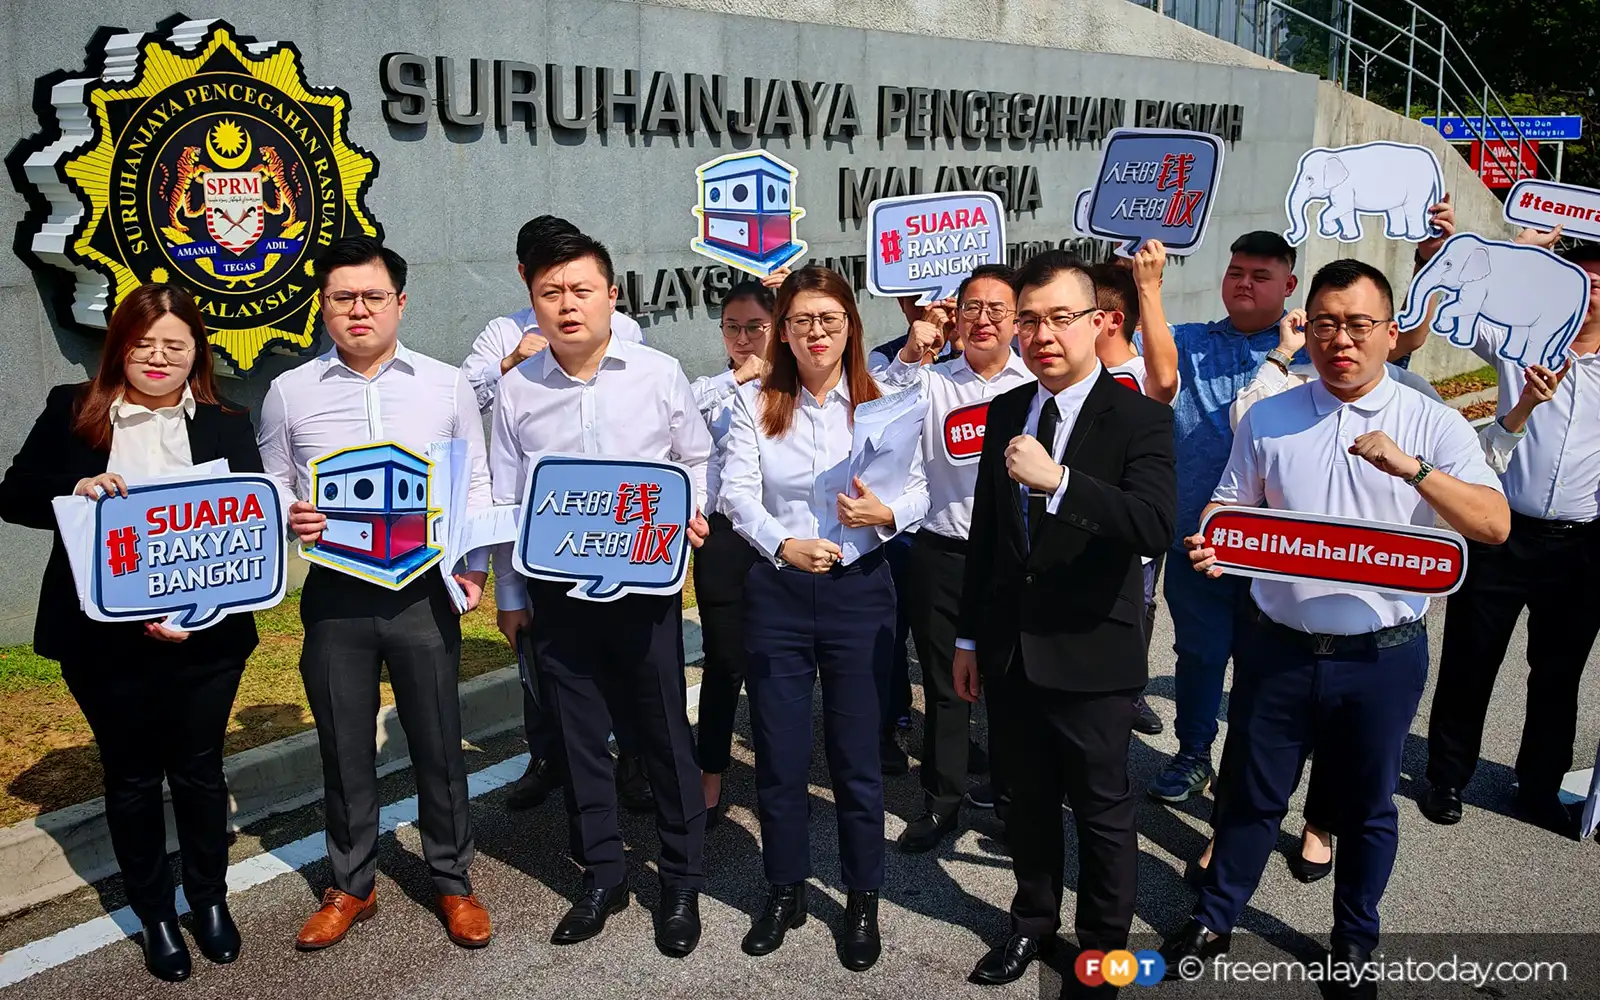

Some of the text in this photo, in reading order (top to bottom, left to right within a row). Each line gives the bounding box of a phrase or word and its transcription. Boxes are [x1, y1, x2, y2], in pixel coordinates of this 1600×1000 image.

[379, 52, 862, 138] SURUHANJAYA
[878, 86, 1125, 141] PENCEGAHAN
[1525, 129, 1565, 137] Malaysia
[120, 83, 336, 255] SURUHANJAYA PENCEGAHAN RASUAH
[206, 177, 260, 195] SPRM
[1104, 152, 1195, 191] 人民的钱
[905, 206, 990, 237] SUARA
[1111, 189, 1204, 227] 人民的权
[177, 245, 217, 257] AMANAH
[265, 241, 289, 250] ADIL
[908, 230, 991, 259] RAKYAT
[223, 262, 256, 272] TEGAS
[908, 253, 990, 281] BANGKIT
[193, 283, 303, 318] ALAYSIA
[145, 492, 267, 538] SUARA
[535, 481, 663, 525] 人民的钱
[147, 525, 266, 568] RAKYAT
[554, 522, 682, 565] 人民的权
[1211, 527, 1452, 576] #BeliMahalKenapa
[147, 555, 266, 598] BANGKIT
